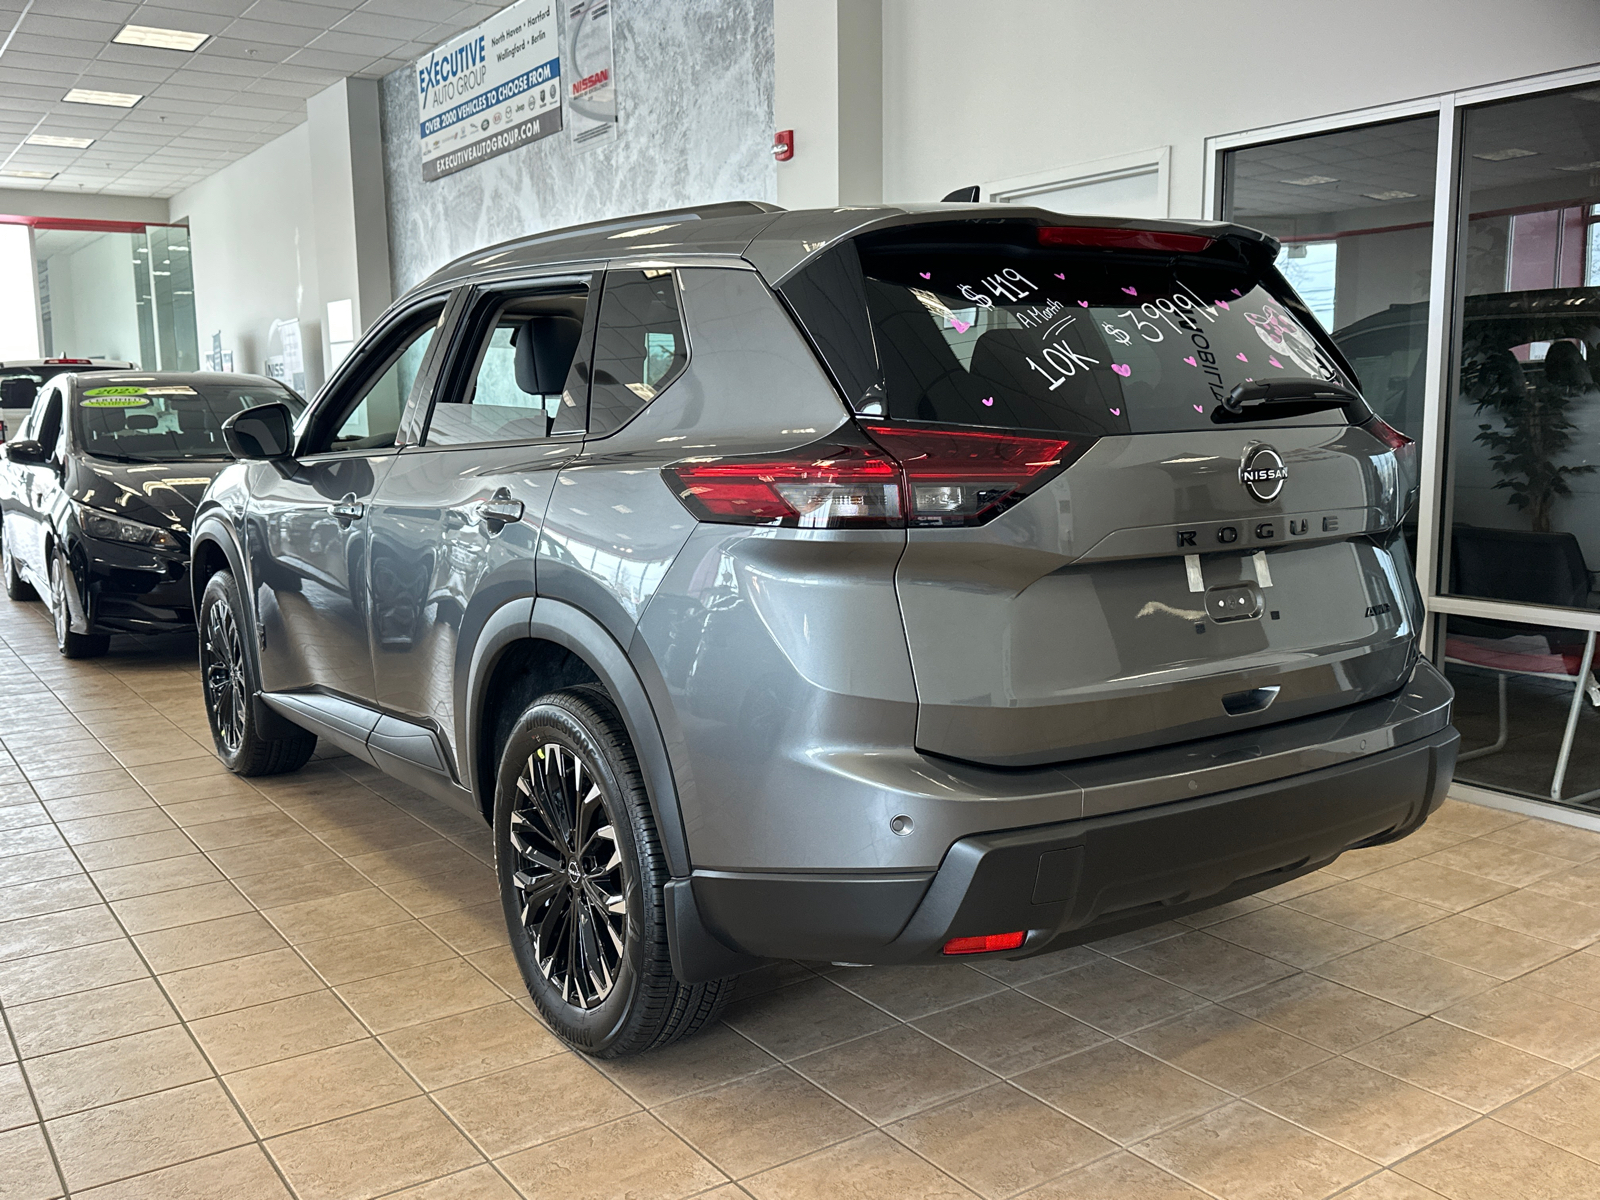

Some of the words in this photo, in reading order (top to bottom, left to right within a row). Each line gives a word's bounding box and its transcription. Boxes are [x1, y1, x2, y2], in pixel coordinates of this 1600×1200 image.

[491, 31, 506, 48] North
[505, 25, 522, 40] Haven
[527, 5, 551, 28] Hartford
[496, 39, 526, 63] Wallingford
[531, 30, 546, 46] Berlin
[419, 34, 486, 110] EXECUTIVE
[432, 81, 455, 108] AUTO
[456, 65, 487, 96] GROUP
[572, 68, 609, 96] NISSAN
[424, 117, 441, 135] OVER
[441, 108, 458, 128] 2000
[457, 93, 488, 121] VEHICLES
[487, 90, 498, 107] TO
[498, 75, 528, 101] CHOOSE
[528, 63, 552, 87] FROM
[436, 119, 541, 173] EXECUTIVEAUTOGROUP.COM
[1016, 312, 1038, 328] A
[1027, 298, 1065, 324] Month
[267, 363, 285, 377] NISS
[1025, 339, 1100, 391] 10K
[94, 386, 141, 396] 2023
[1243, 468, 1289, 482] NISSAN
[1176, 515, 1340, 548] ROGUE
